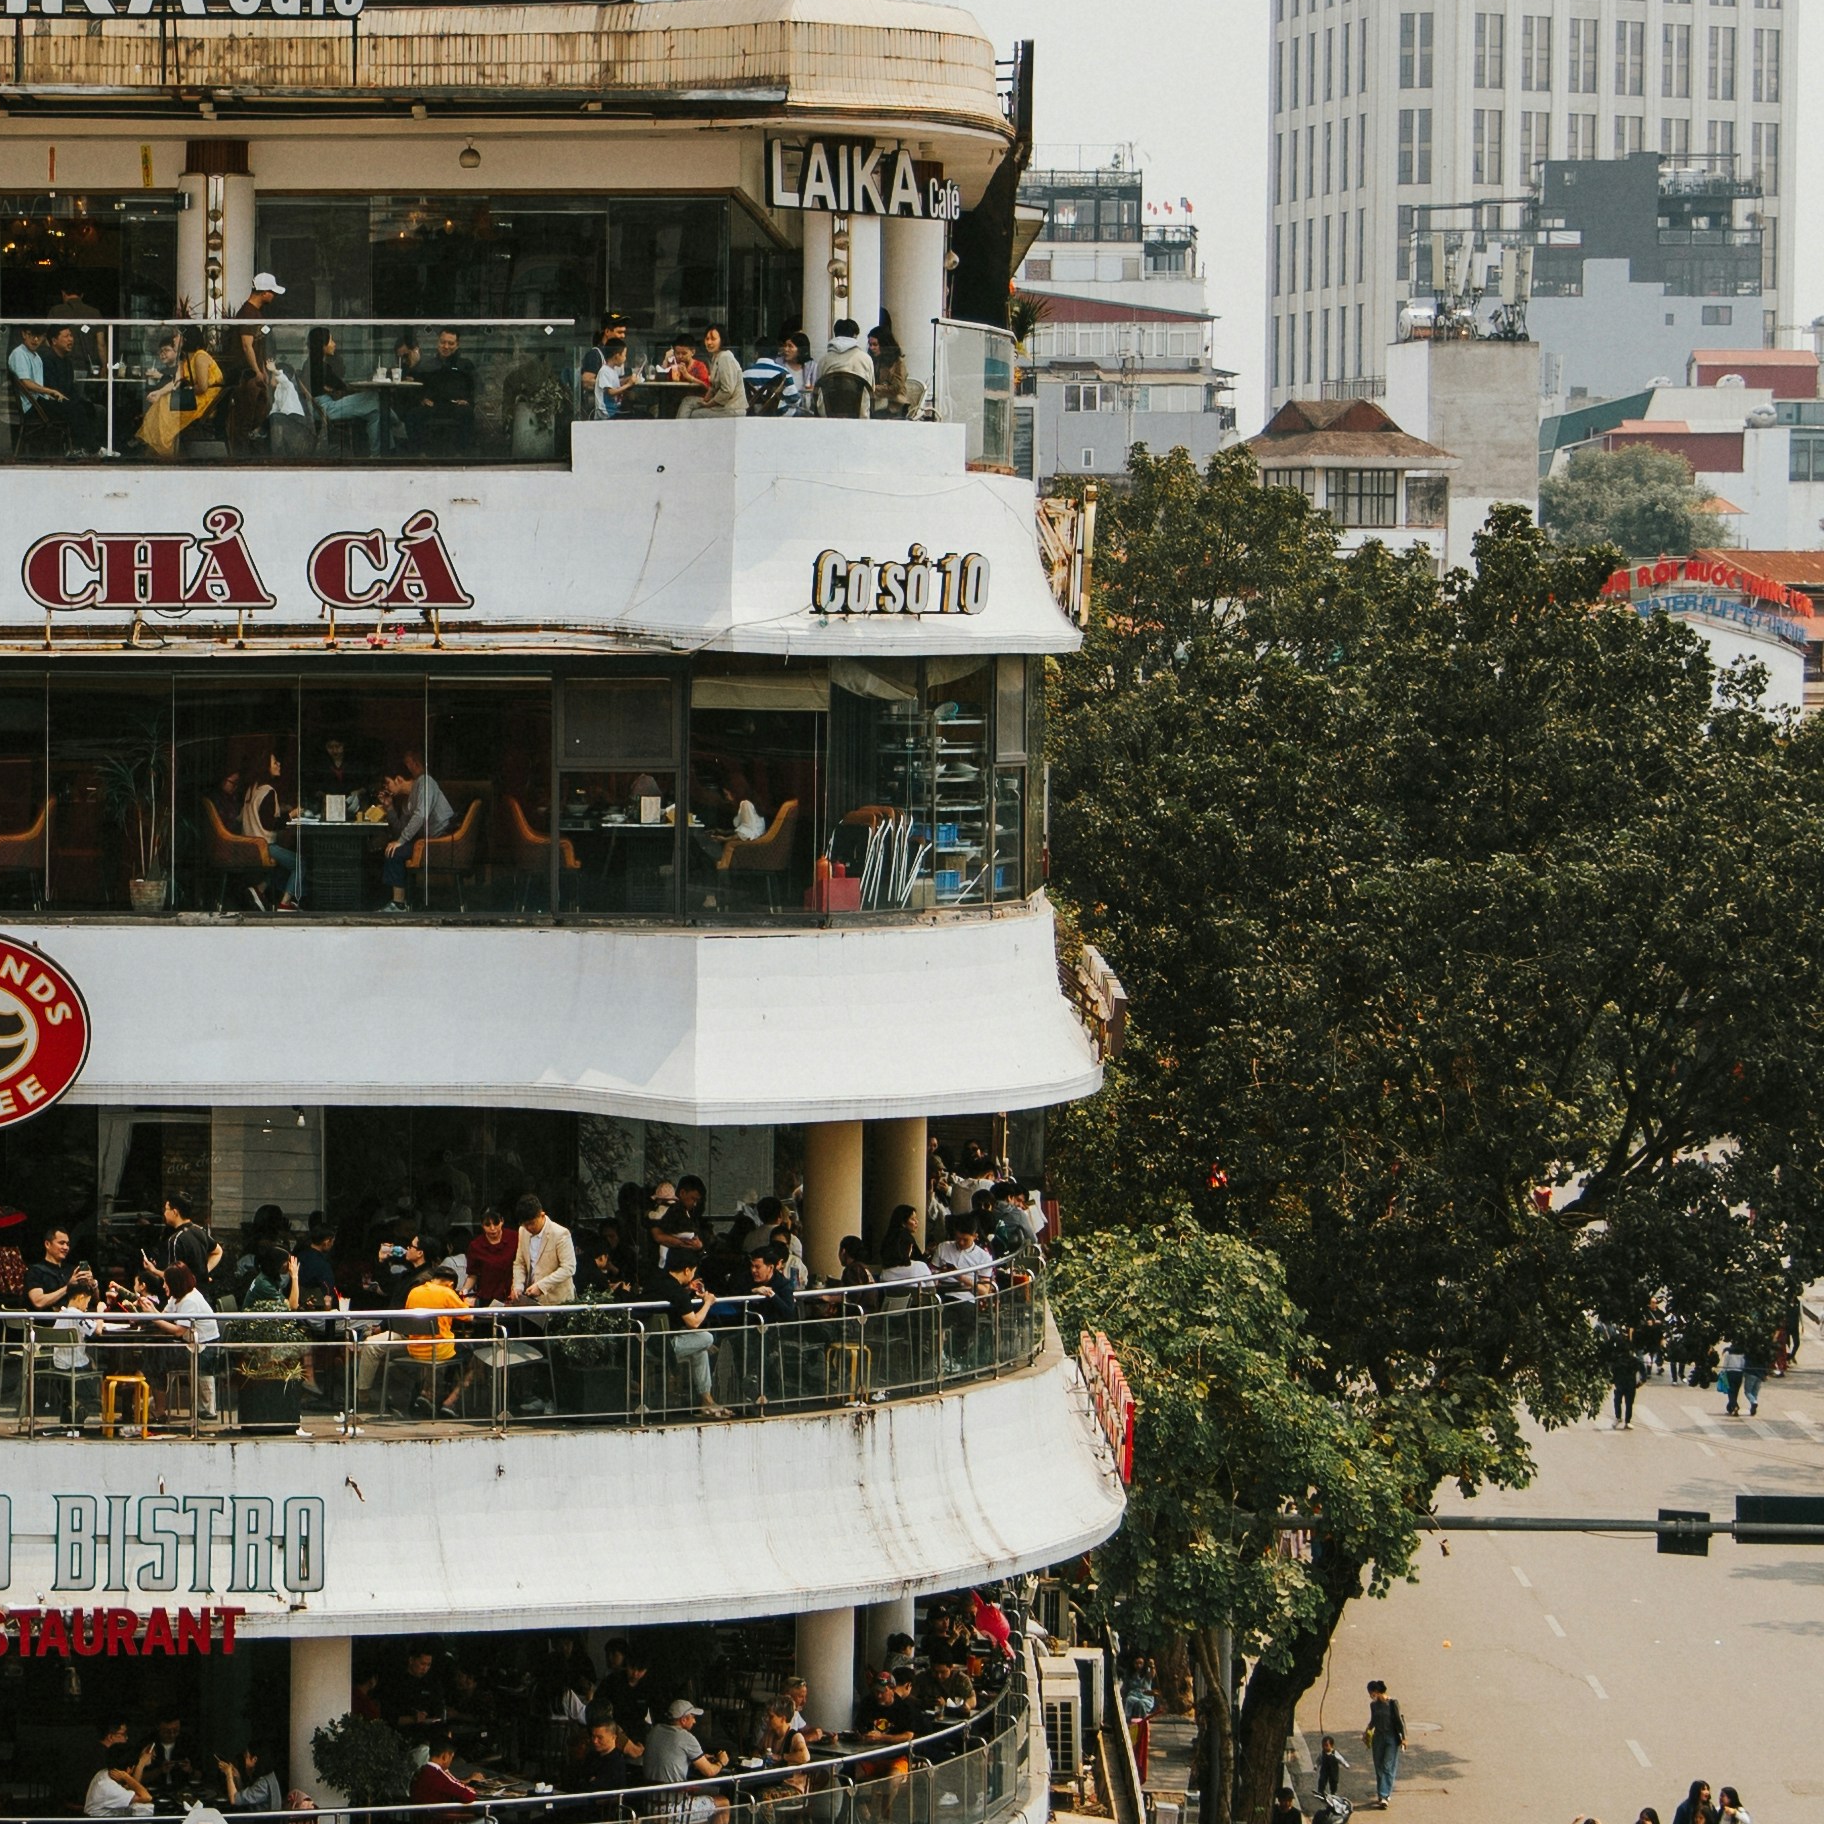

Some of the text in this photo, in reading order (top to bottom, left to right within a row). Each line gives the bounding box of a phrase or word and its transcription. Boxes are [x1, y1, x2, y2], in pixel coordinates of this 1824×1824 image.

[767, 138, 960, 220] LAIKA Café
[21, 504, 278, 611] CHẢ
[306, 508, 475, 611] CÁ
[812, 549, 874, 614] Cơ
[937, 553, 991, 615] 10
[52, 1494, 325, 1593] BISTRO
